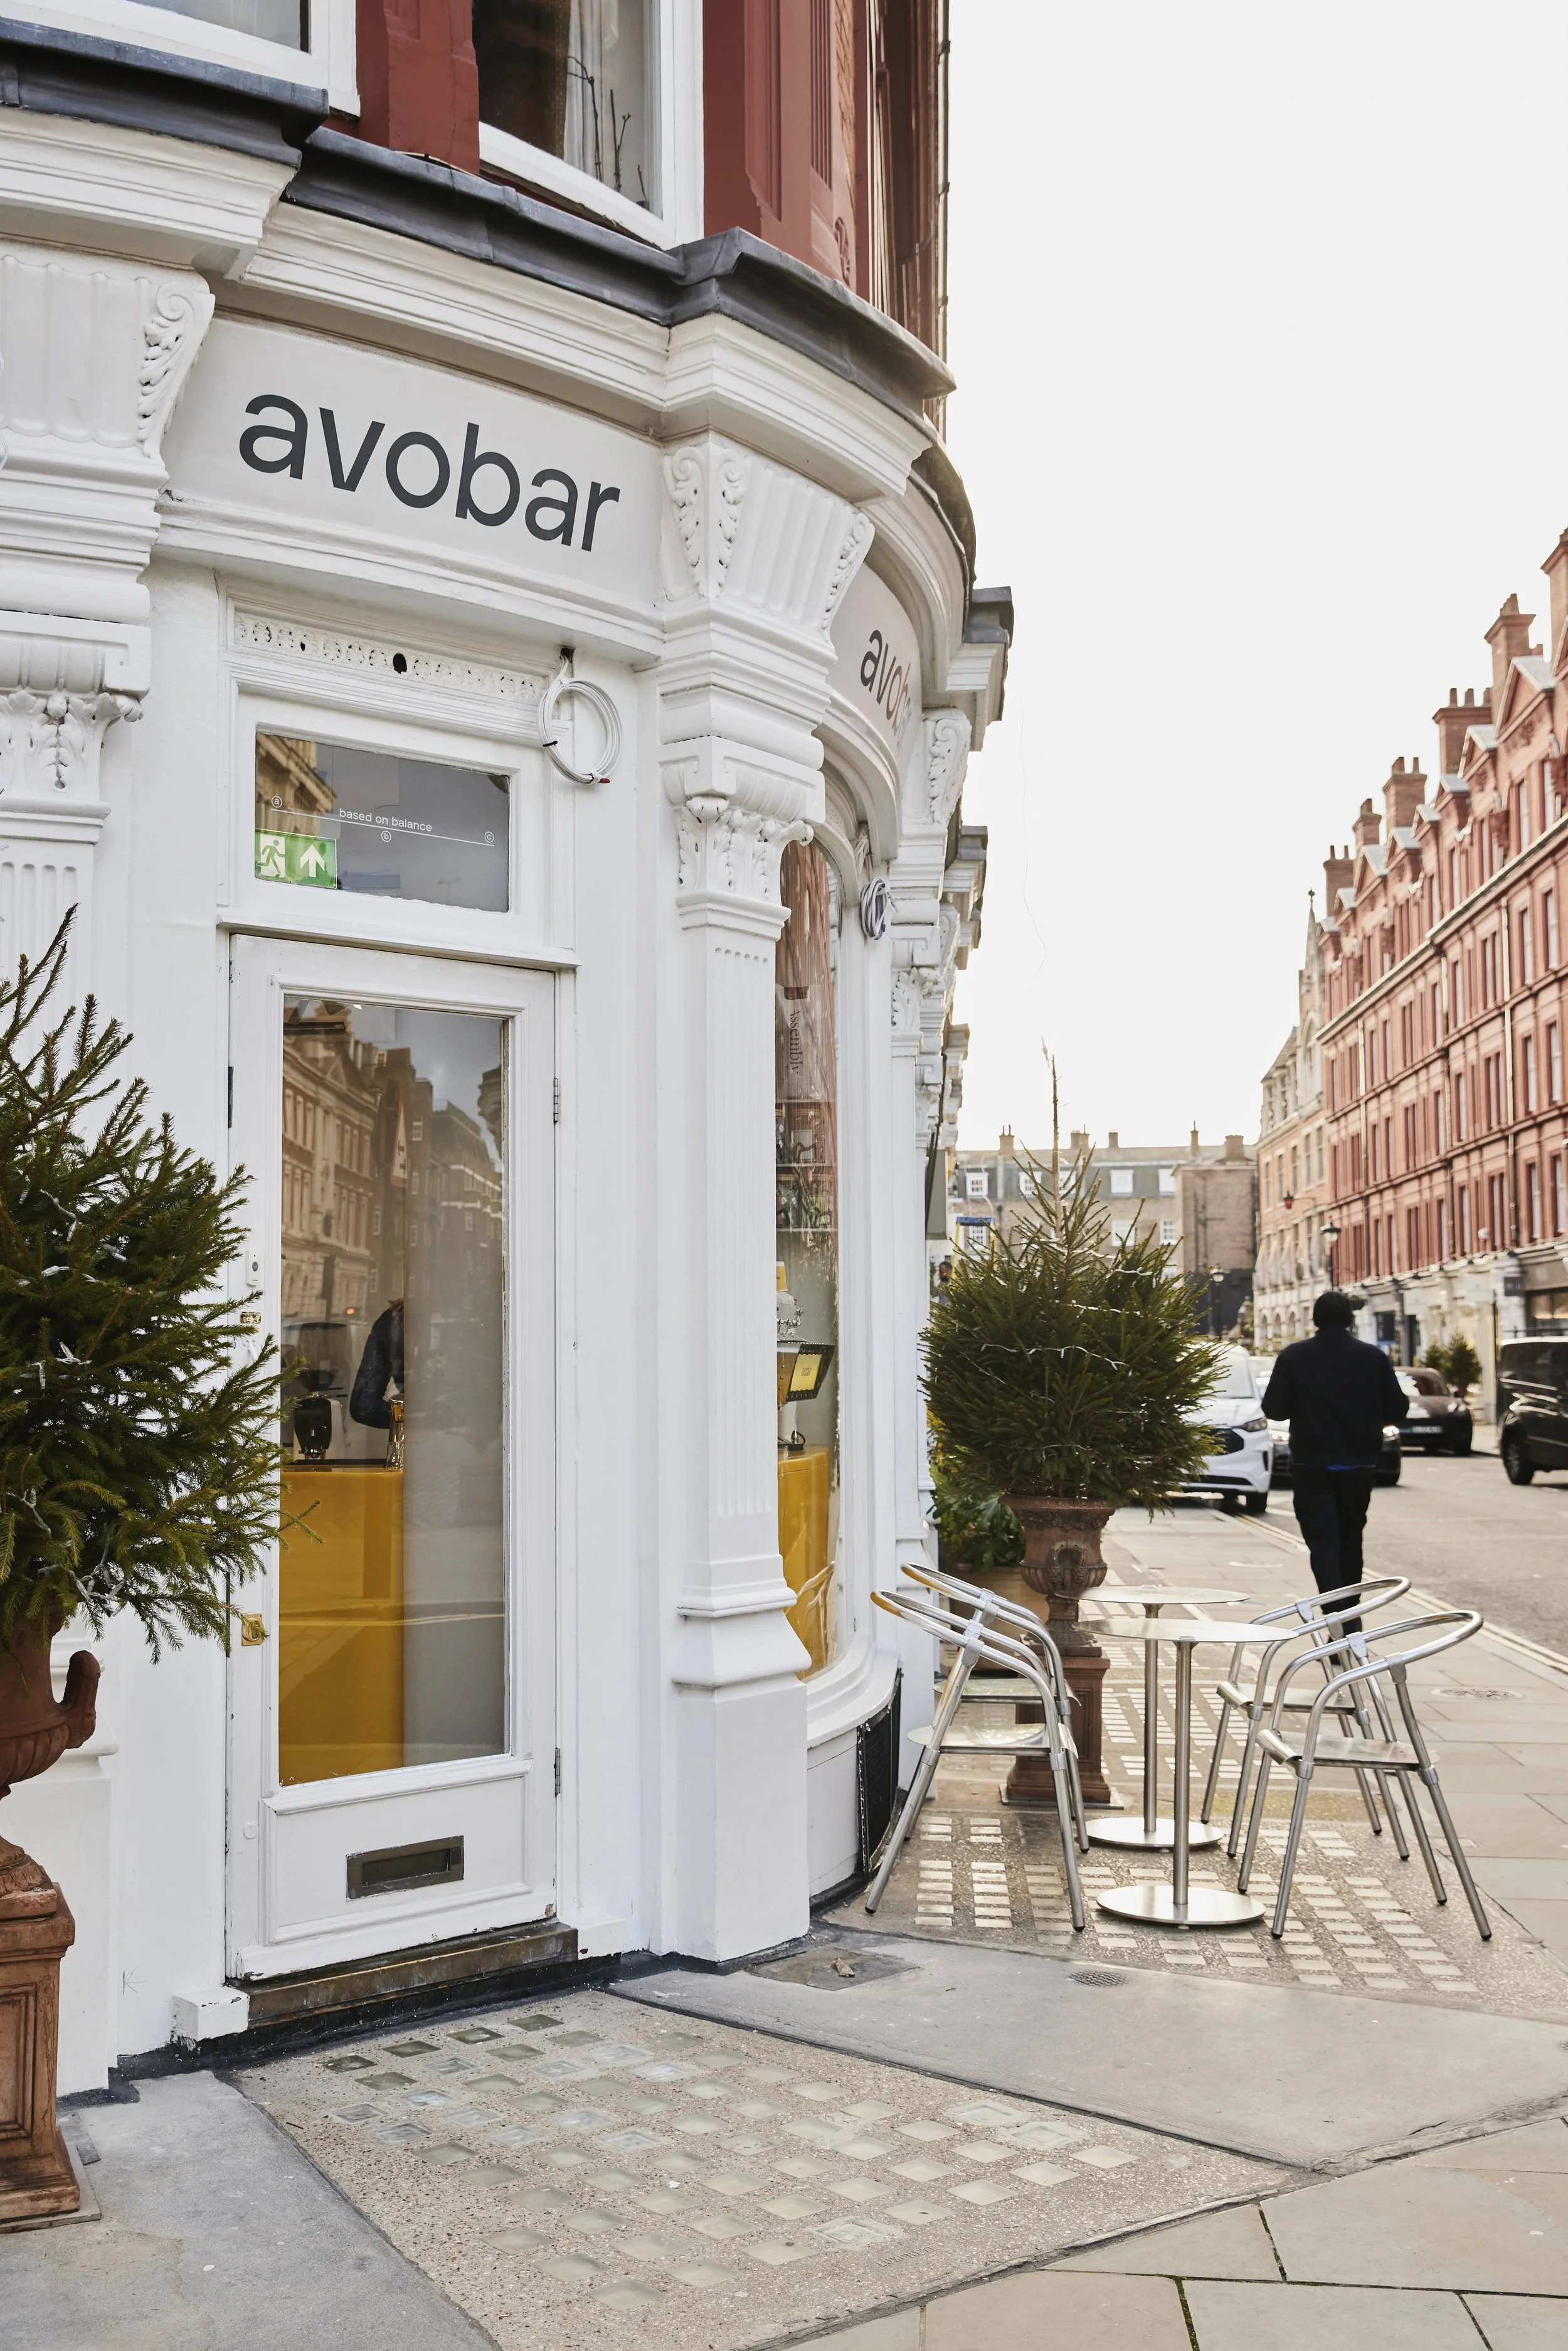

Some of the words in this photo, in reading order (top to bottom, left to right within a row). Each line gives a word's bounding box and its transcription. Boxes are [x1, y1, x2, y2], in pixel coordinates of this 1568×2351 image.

[239, 394, 620, 552] avobar
[339, 807, 372, 822] based
[375, 816, 388, 825] on
[391, 817, 432, 832] balance
[786, 1009, 803, 1074] Assembly
